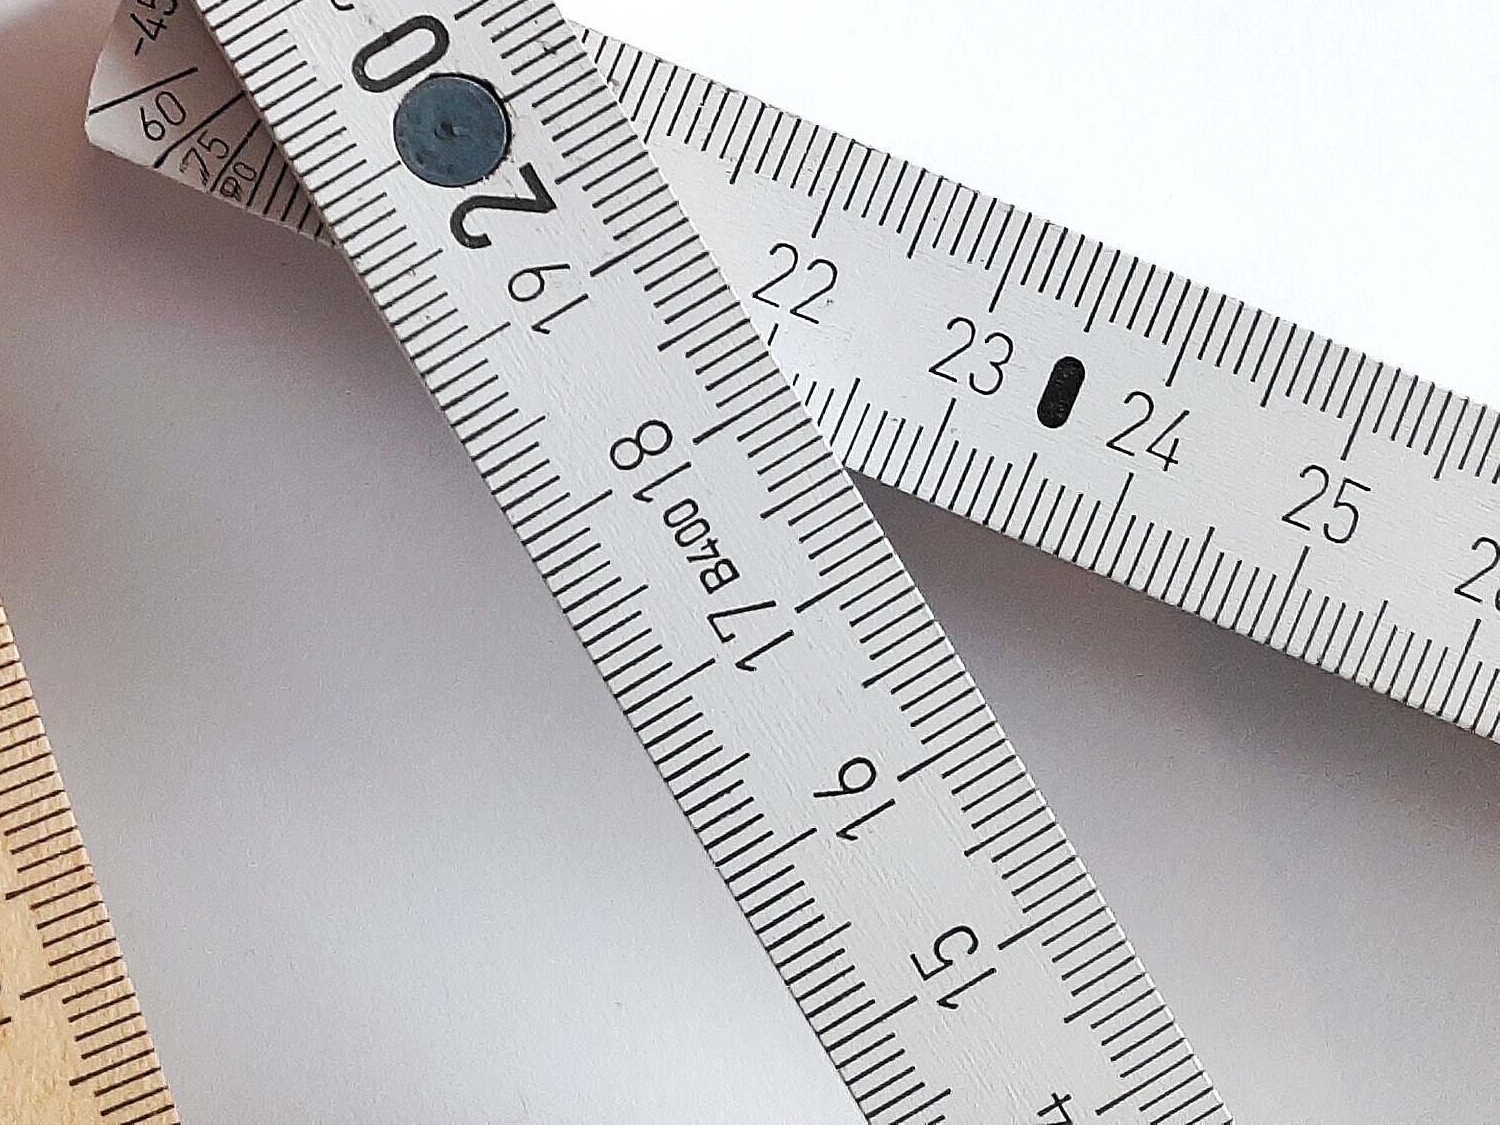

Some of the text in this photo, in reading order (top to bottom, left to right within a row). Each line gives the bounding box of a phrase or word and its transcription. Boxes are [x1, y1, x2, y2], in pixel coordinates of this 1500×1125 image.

[140, 90, 186, 141] 60
[351, 14, 558, 249] 20
[180, 130, 230, 186] 75
[507, 263, 589, 335] 19
[751, 242, 838, 324] 22
[928, 316, 1013, 395] 23
[609, 419, 691, 504] 18
[1106, 391, 1190, 472] 24
[1281, 464, 1371, 544] 25
[663, 498, 740, 595] B400
[1454, 537, 1500, 611] 2
[708, 600, 795, 672] 17
[813, 757, 896, 842] 16
[909, 924, 997, 1010] 15
